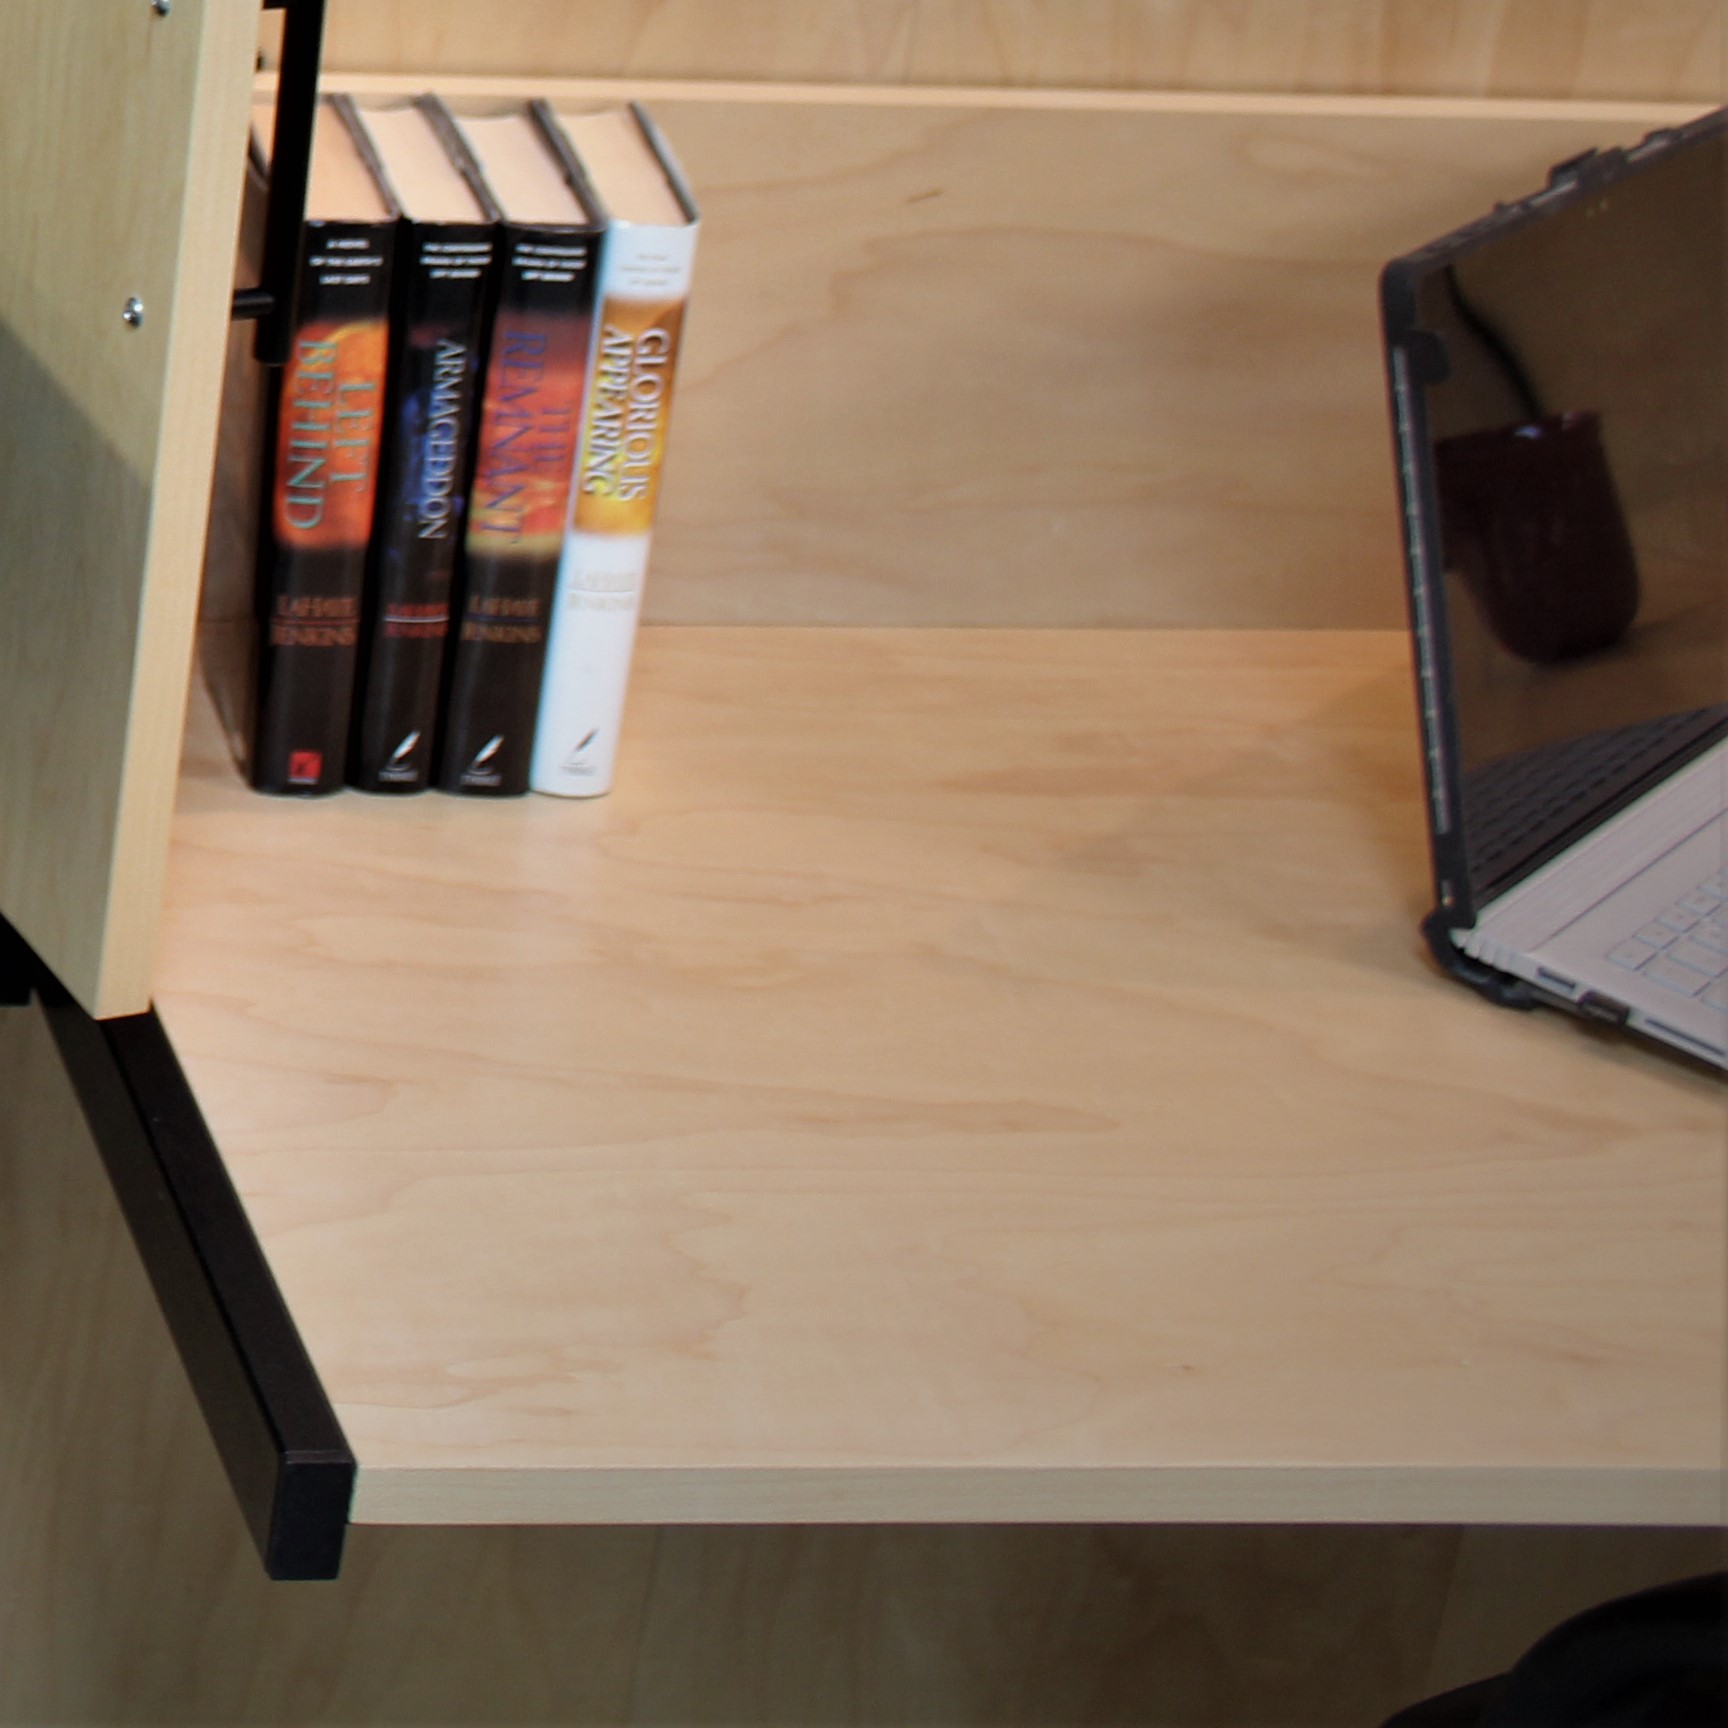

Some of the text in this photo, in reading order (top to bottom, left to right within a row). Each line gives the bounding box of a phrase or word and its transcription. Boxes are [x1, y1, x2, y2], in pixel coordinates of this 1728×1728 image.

[284, 339, 338, 530] BEHIND
[330, 380, 377, 493] LEFT
[417, 337, 468, 540] ARMAGEDDON
[480, 331, 549, 545] REMNANT
[582, 324, 635, 496] APPEARING
[617, 327, 671, 503] GLORIOUS
